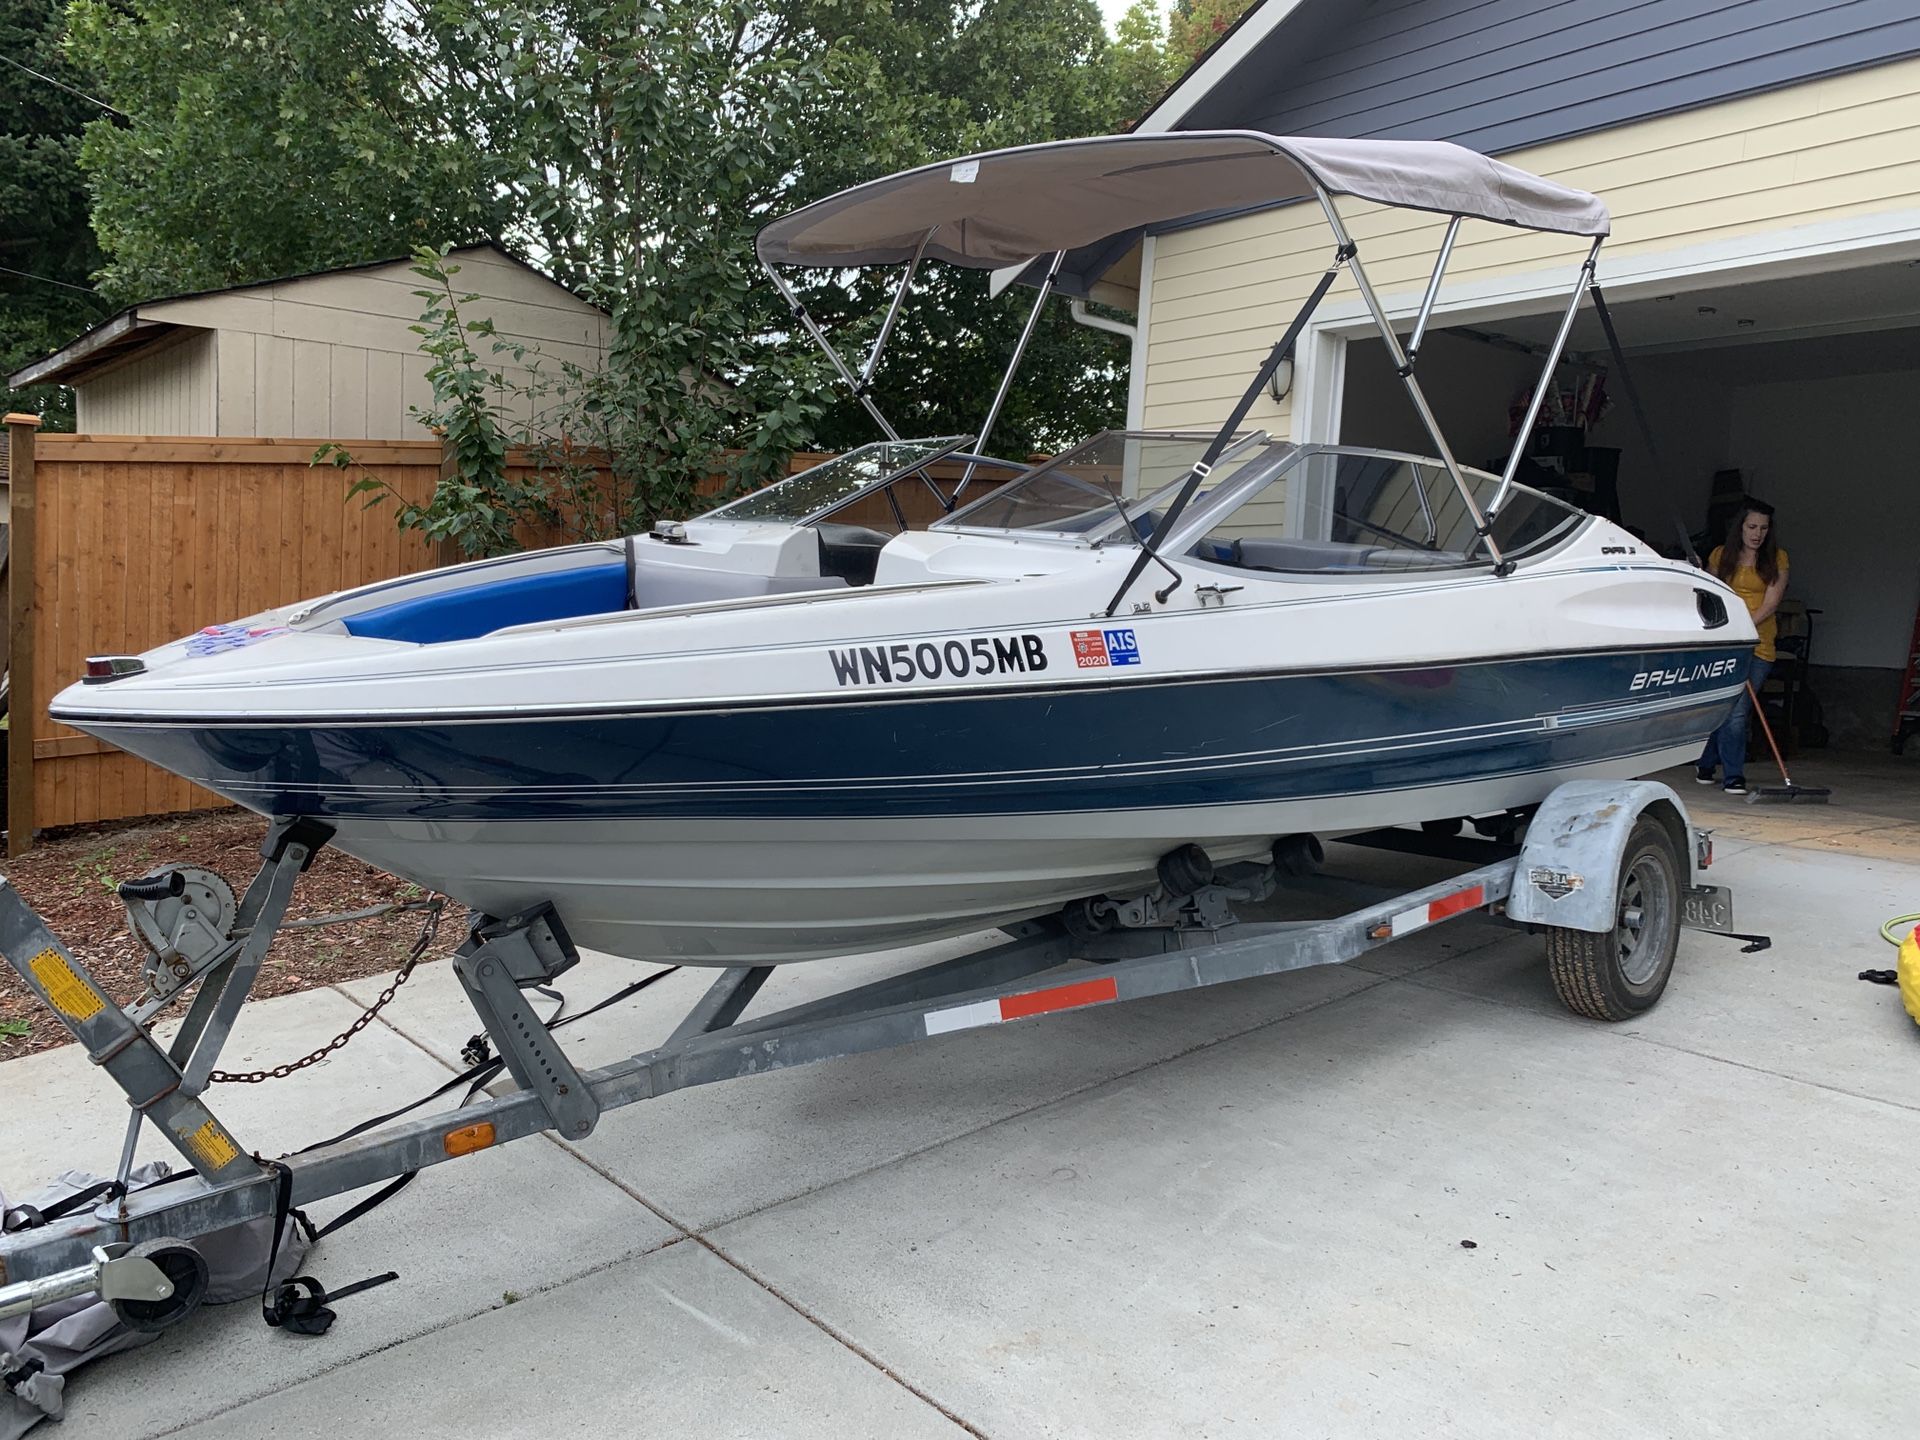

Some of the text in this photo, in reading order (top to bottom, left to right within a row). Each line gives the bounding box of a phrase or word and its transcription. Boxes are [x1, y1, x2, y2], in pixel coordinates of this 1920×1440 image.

[1108, 631, 1136, 651] AIS
[828, 634, 1048, 687] WN5005MB
[1078, 655, 1107, 667] 2020
[1629, 658, 1737, 691] BAYLINER
